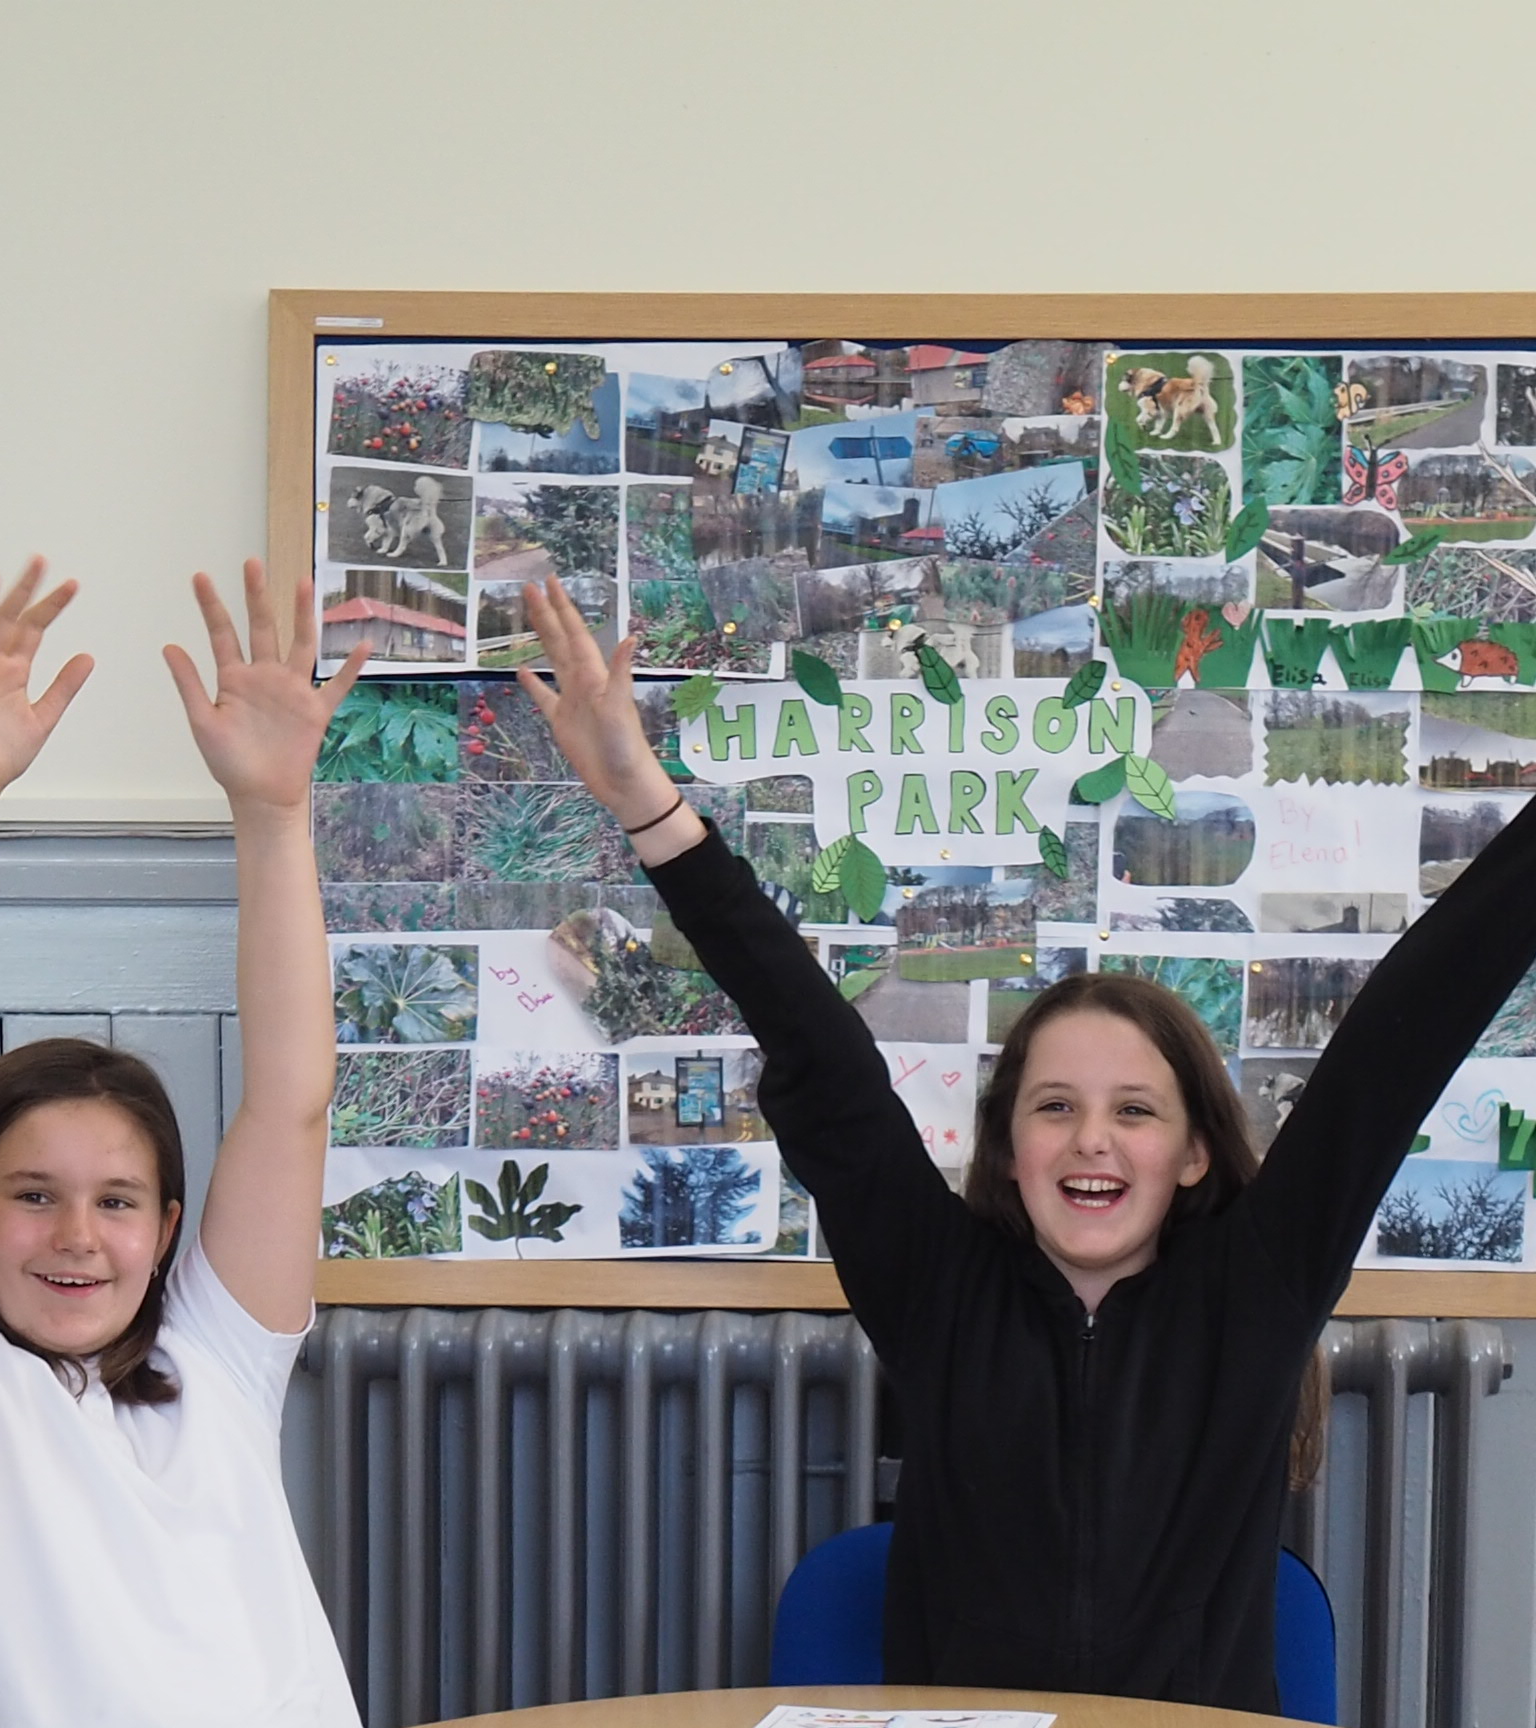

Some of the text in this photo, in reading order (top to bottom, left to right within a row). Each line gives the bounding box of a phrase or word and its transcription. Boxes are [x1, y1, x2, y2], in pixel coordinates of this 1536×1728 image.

[1272, 662, 1327, 686] Elisa
[705, 693, 1136, 761] HARRISON
[846, 768, 1042, 835] PARK
[488, 965, 520, 986] by
